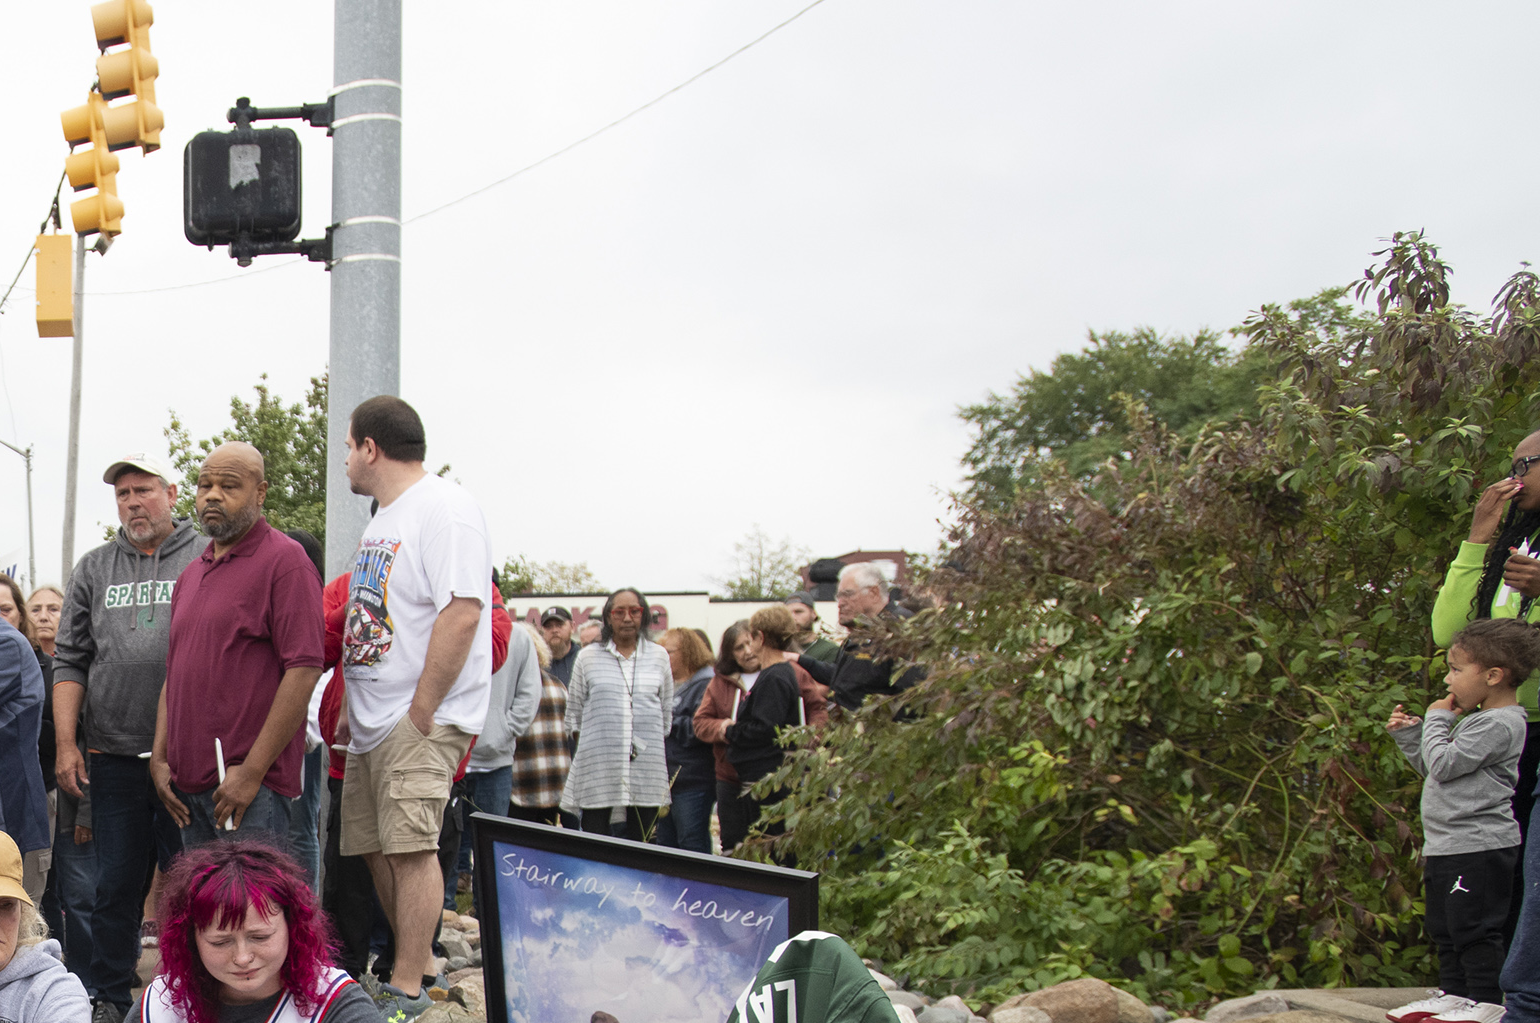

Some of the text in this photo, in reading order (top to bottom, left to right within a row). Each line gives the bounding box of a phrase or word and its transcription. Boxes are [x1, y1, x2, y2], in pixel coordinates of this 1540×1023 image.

[105, 580, 177, 609] SPARTA
[500, 853, 774, 931] Stairway to heaven
